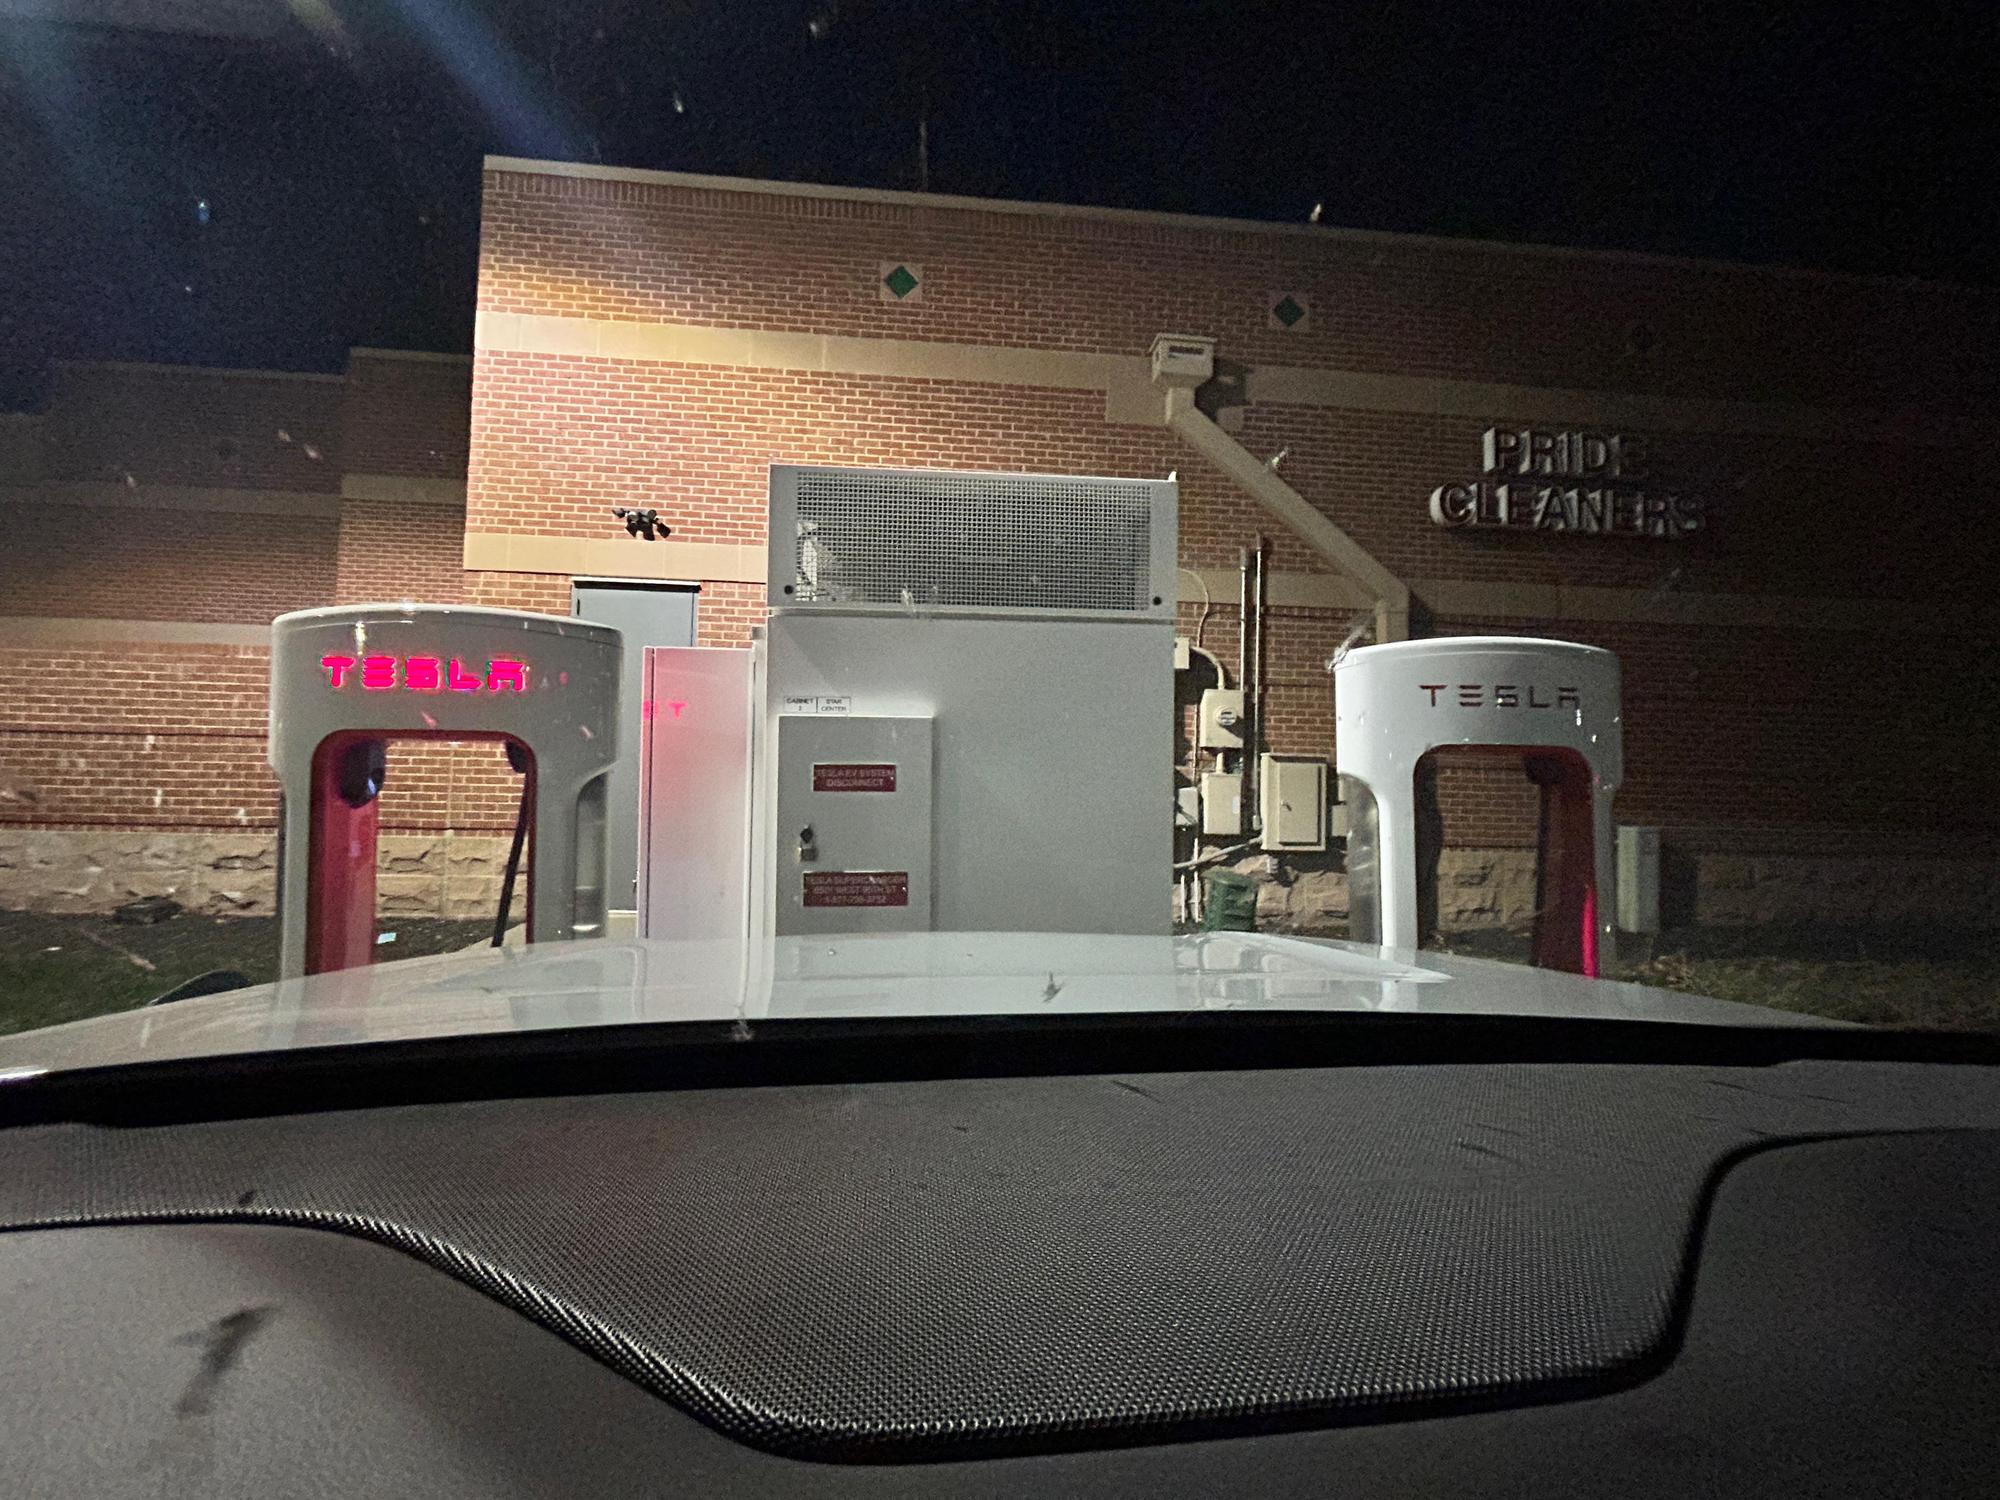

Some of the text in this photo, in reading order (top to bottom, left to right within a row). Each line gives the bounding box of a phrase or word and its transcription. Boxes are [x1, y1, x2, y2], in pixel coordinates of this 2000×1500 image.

[1482, 427, 1647, 477] PRIDE
[1429, 481, 1705, 537] CLEANERS
[320, 656, 527, 691] TESLA
[1418, 684, 1580, 709] TESLA
